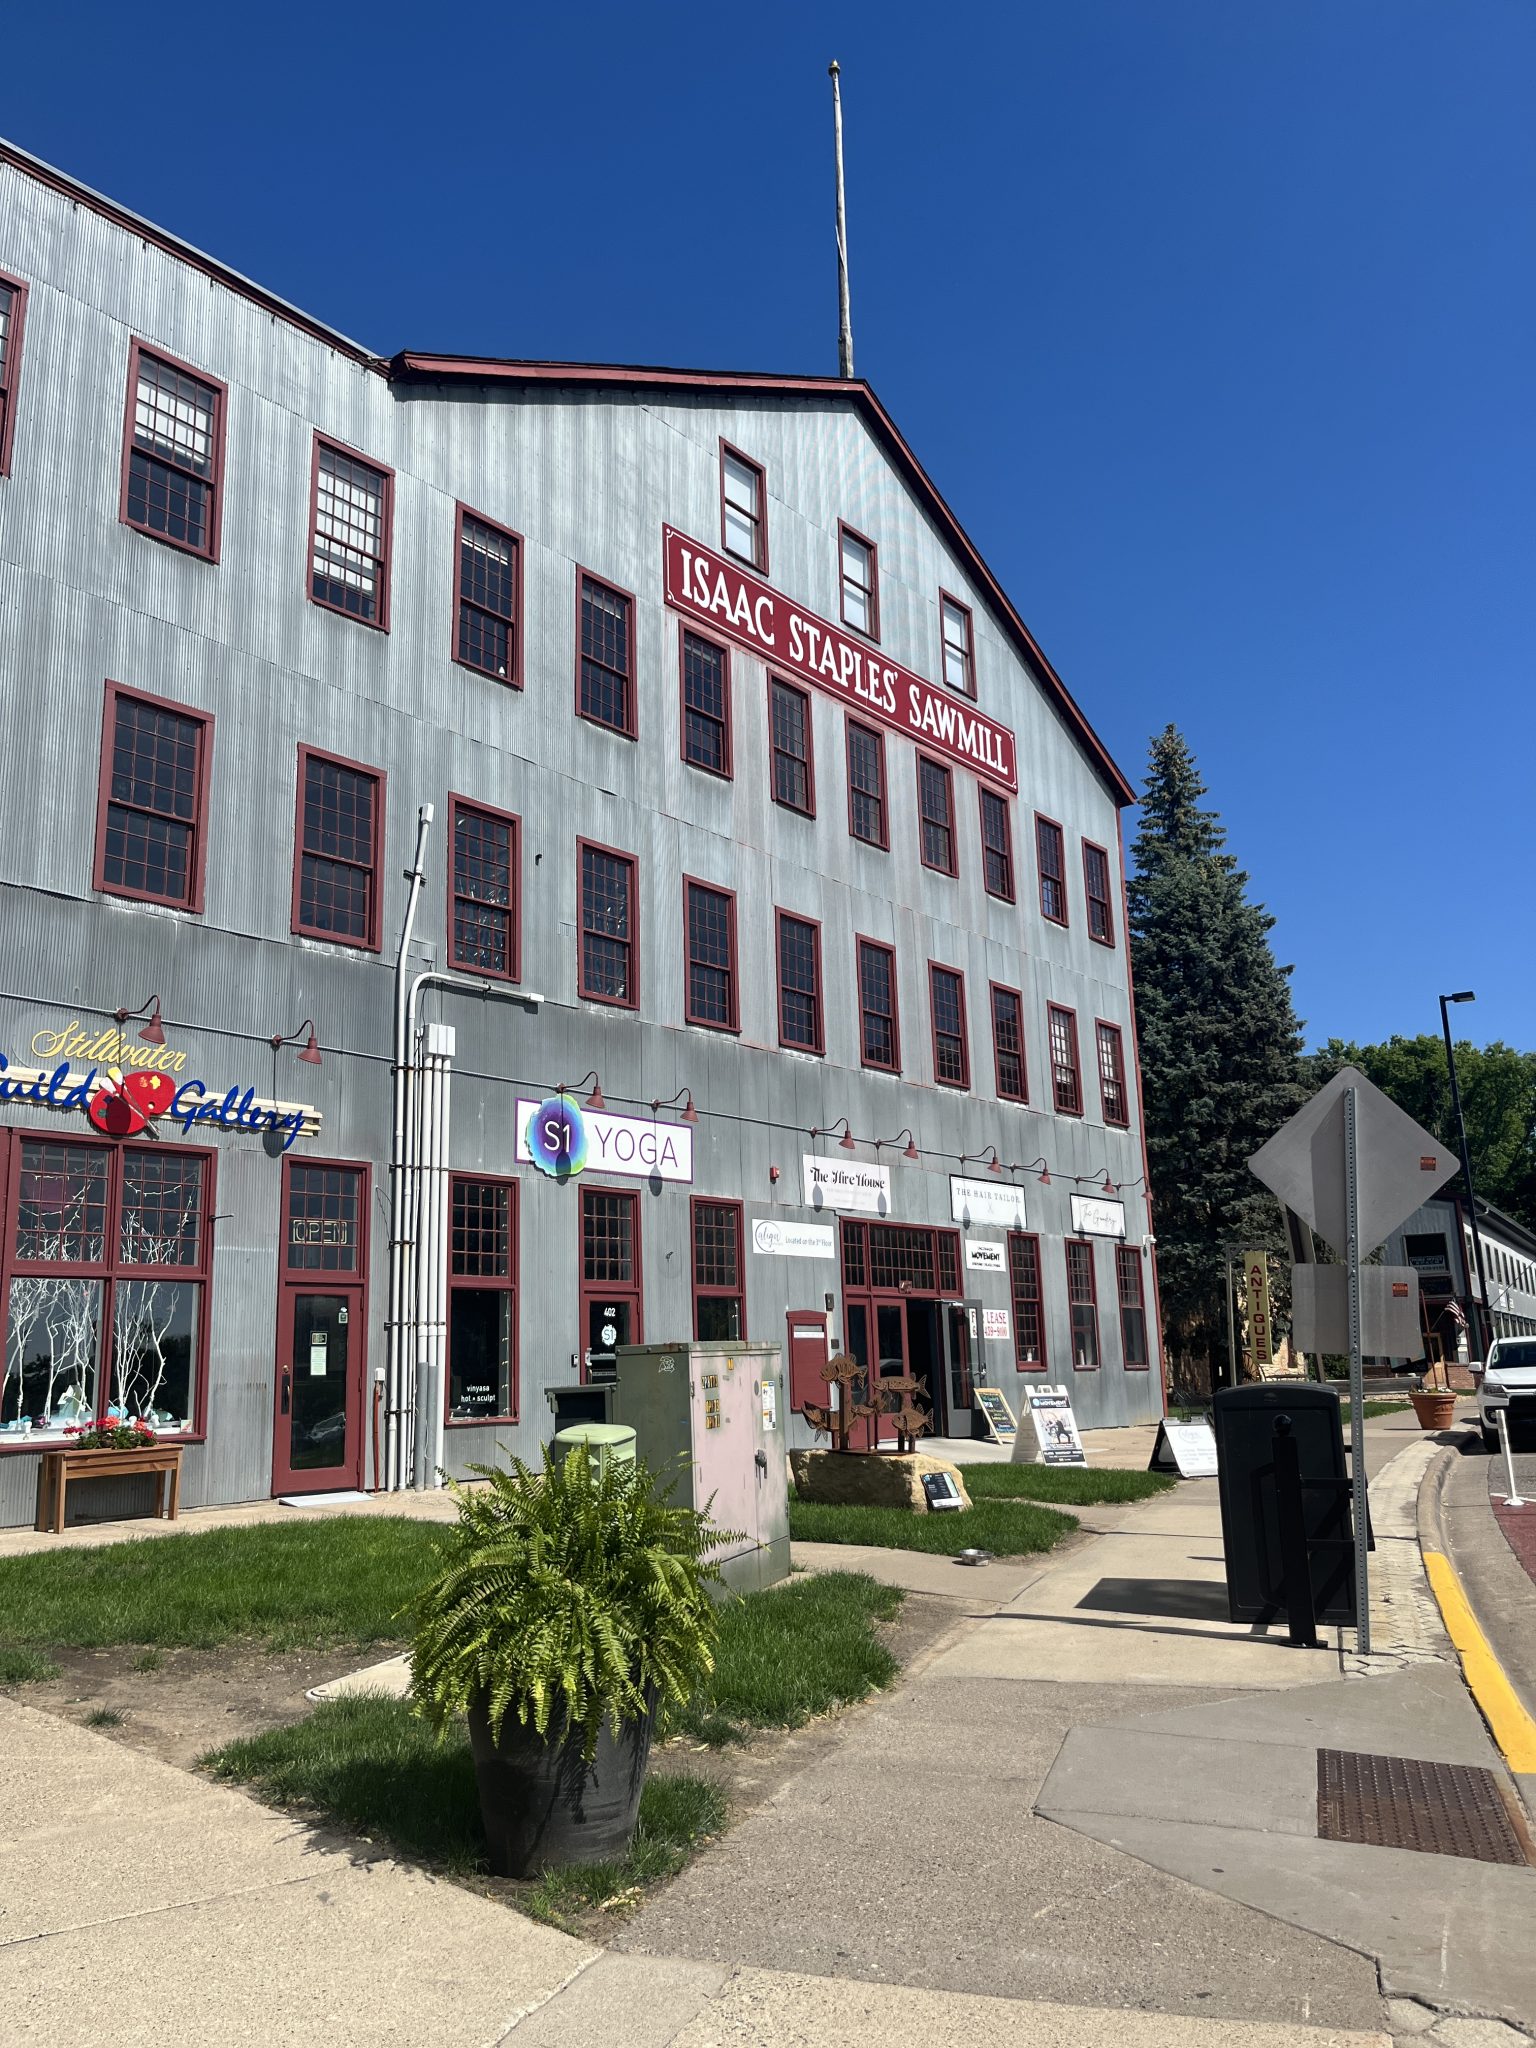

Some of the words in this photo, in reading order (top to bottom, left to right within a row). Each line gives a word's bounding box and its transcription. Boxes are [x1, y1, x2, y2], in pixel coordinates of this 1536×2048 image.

[680, 547, 775, 650] ISAAC
[908, 683, 1009, 776] SAWMILL
[31, 1020, 188, 1072] Stillwater
[171, 1079, 305, 1151] Gallery
[543, 1120, 571, 1153] S1
[594, 1124, 679, 1169] YOGA
[810, 1166, 829, 1183] The
[832, 1170, 855, 1185] Hire
[856, 1173, 885, 1189] House
[956, 1187, 971, 1197] THE
[974, 1189, 992, 1200] HAIR
[994, 1192, 1021, 1204] TAILOR
[296, 1221, 346, 1243] OPEN
[785, 1236, 802, 1245] Located
[822, 1239, 832, 1247] Floor
[971, 1251, 1000, 1261] MOVEMENT
[604, 1307, 616, 1317] 402
[986, 1311, 1007, 1324] LEASE
[1250, 1264, 1267, 1360] ANTIQUES
[604, 1329, 614, 1341] S1
[466, 1384, 490, 1394] vinyasa
[461, 1394, 471, 1402] hot
[477, 1394, 496, 1403] sculpt
